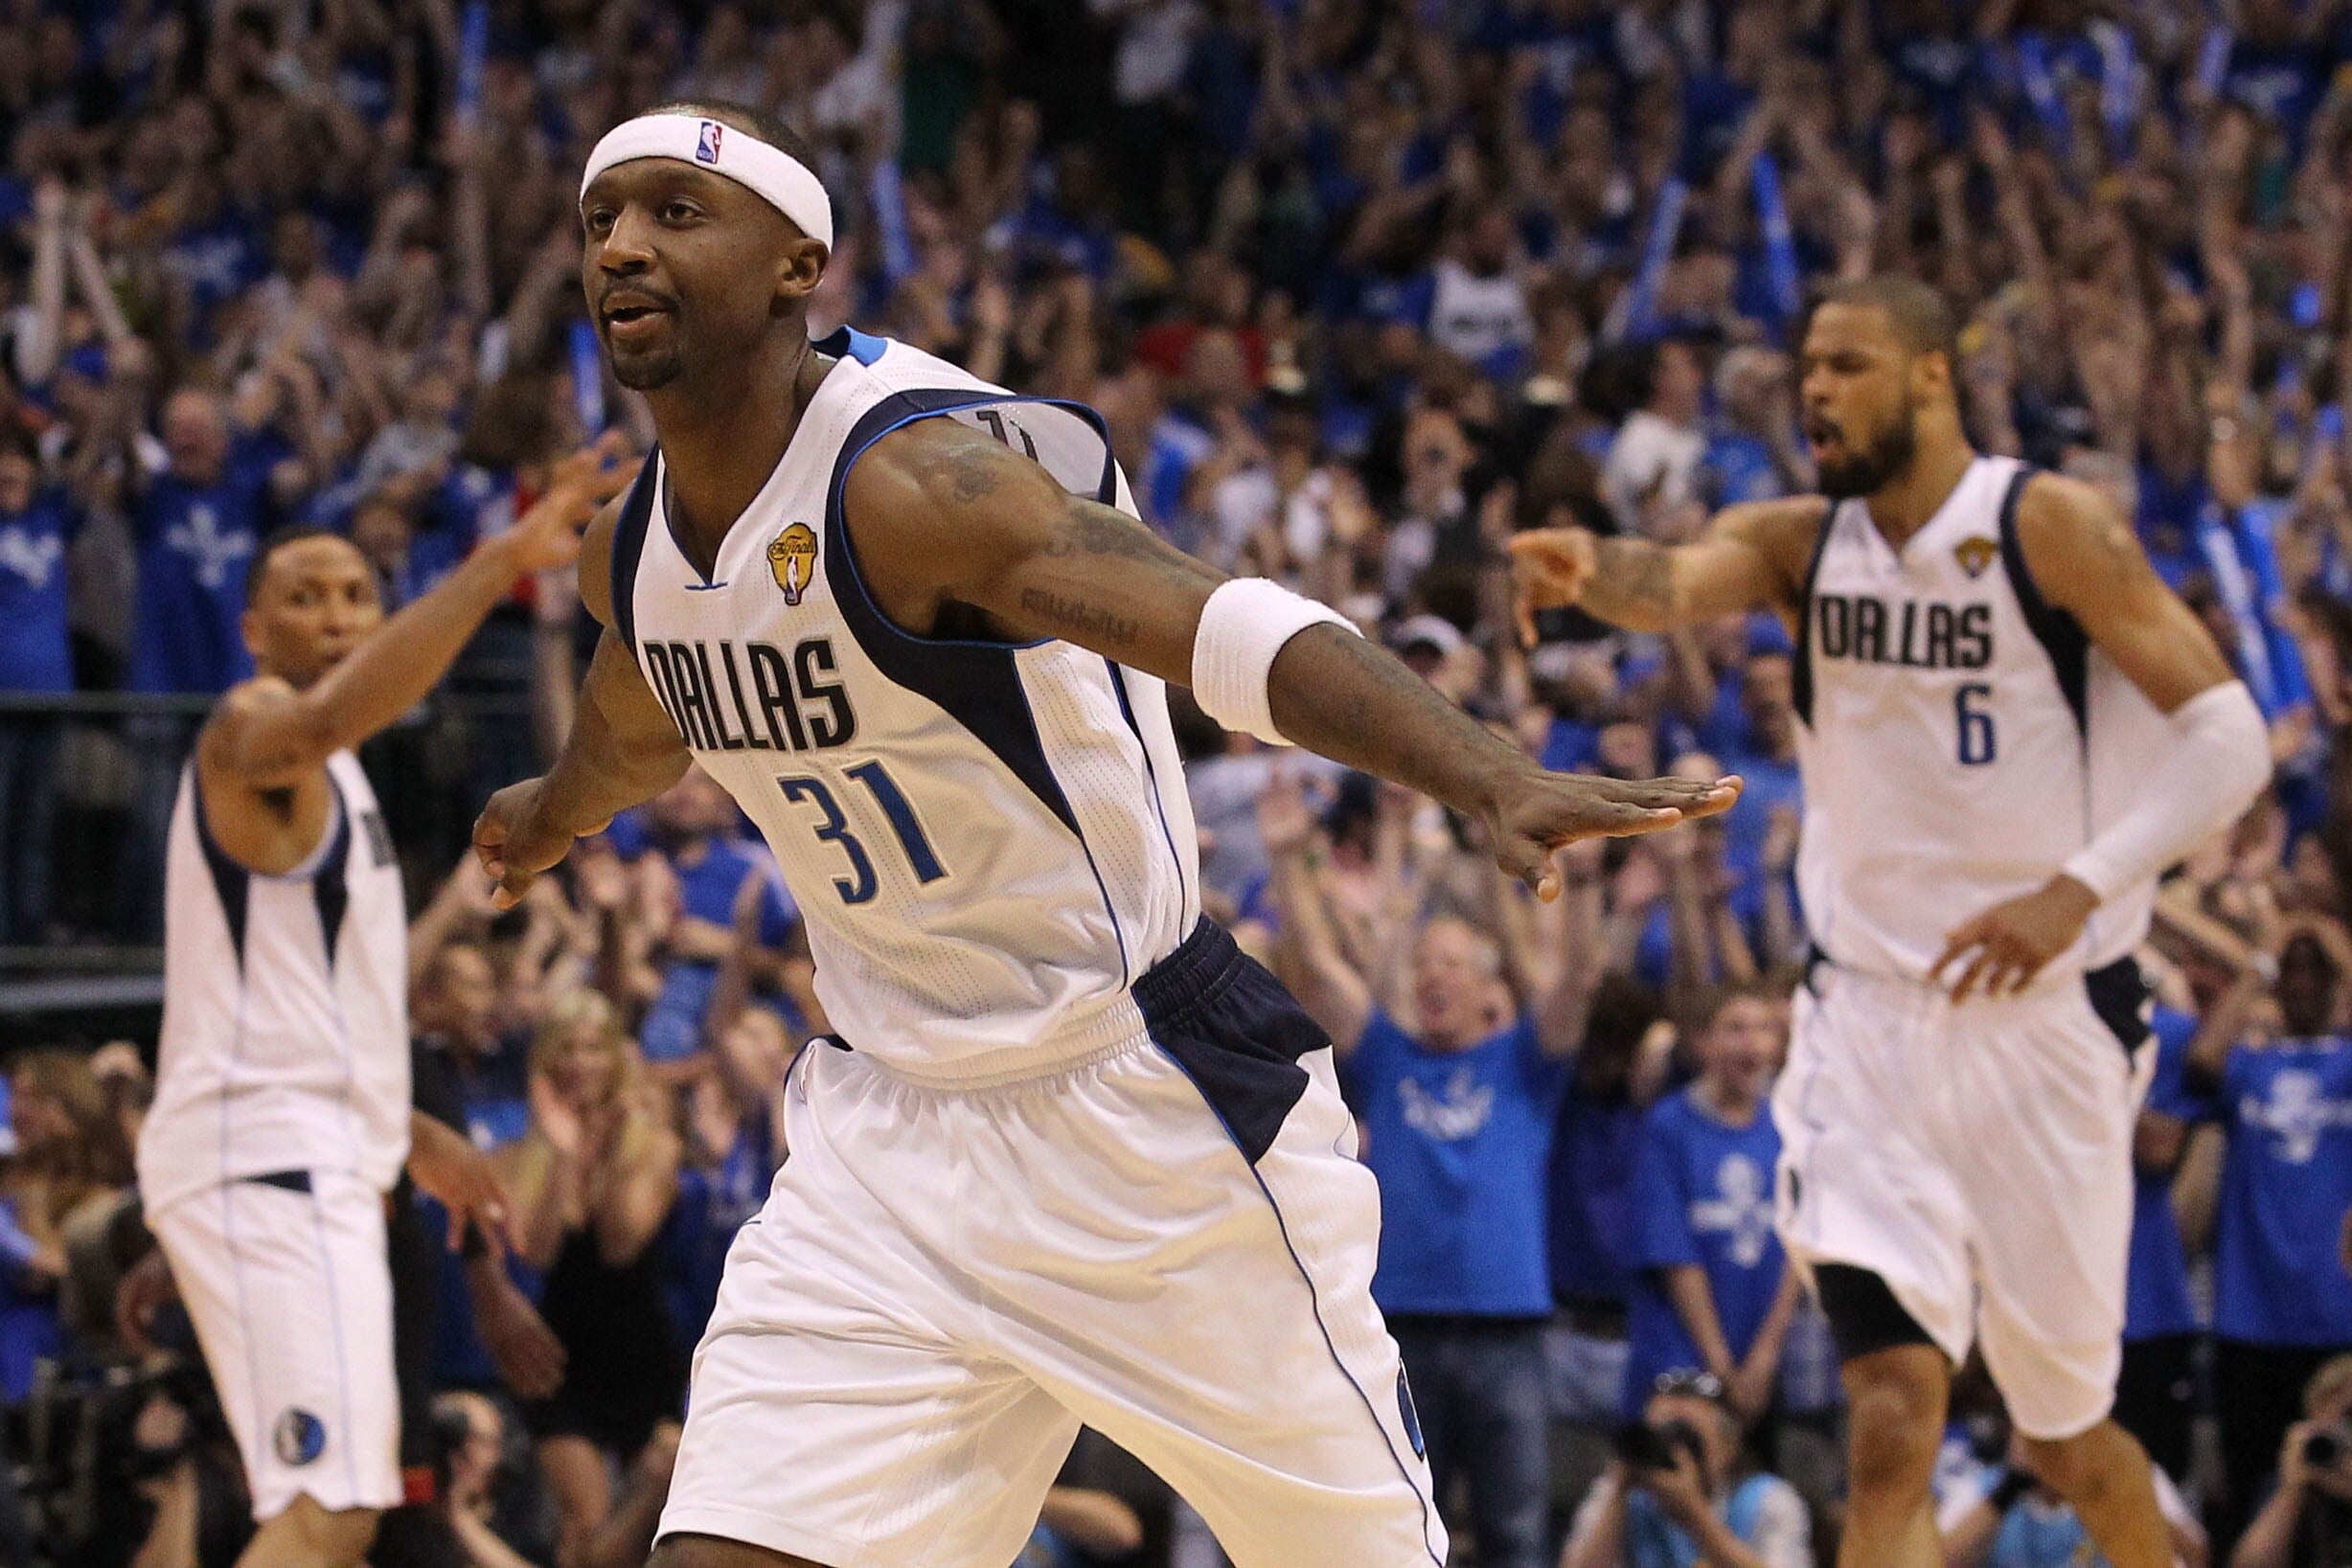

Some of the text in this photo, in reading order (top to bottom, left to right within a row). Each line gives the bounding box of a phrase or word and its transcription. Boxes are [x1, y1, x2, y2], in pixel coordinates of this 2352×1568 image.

[643, 640, 856, 750] DALLAS
[1954, 683, 1996, 765] 6
[777, 760, 948, 903] 31
